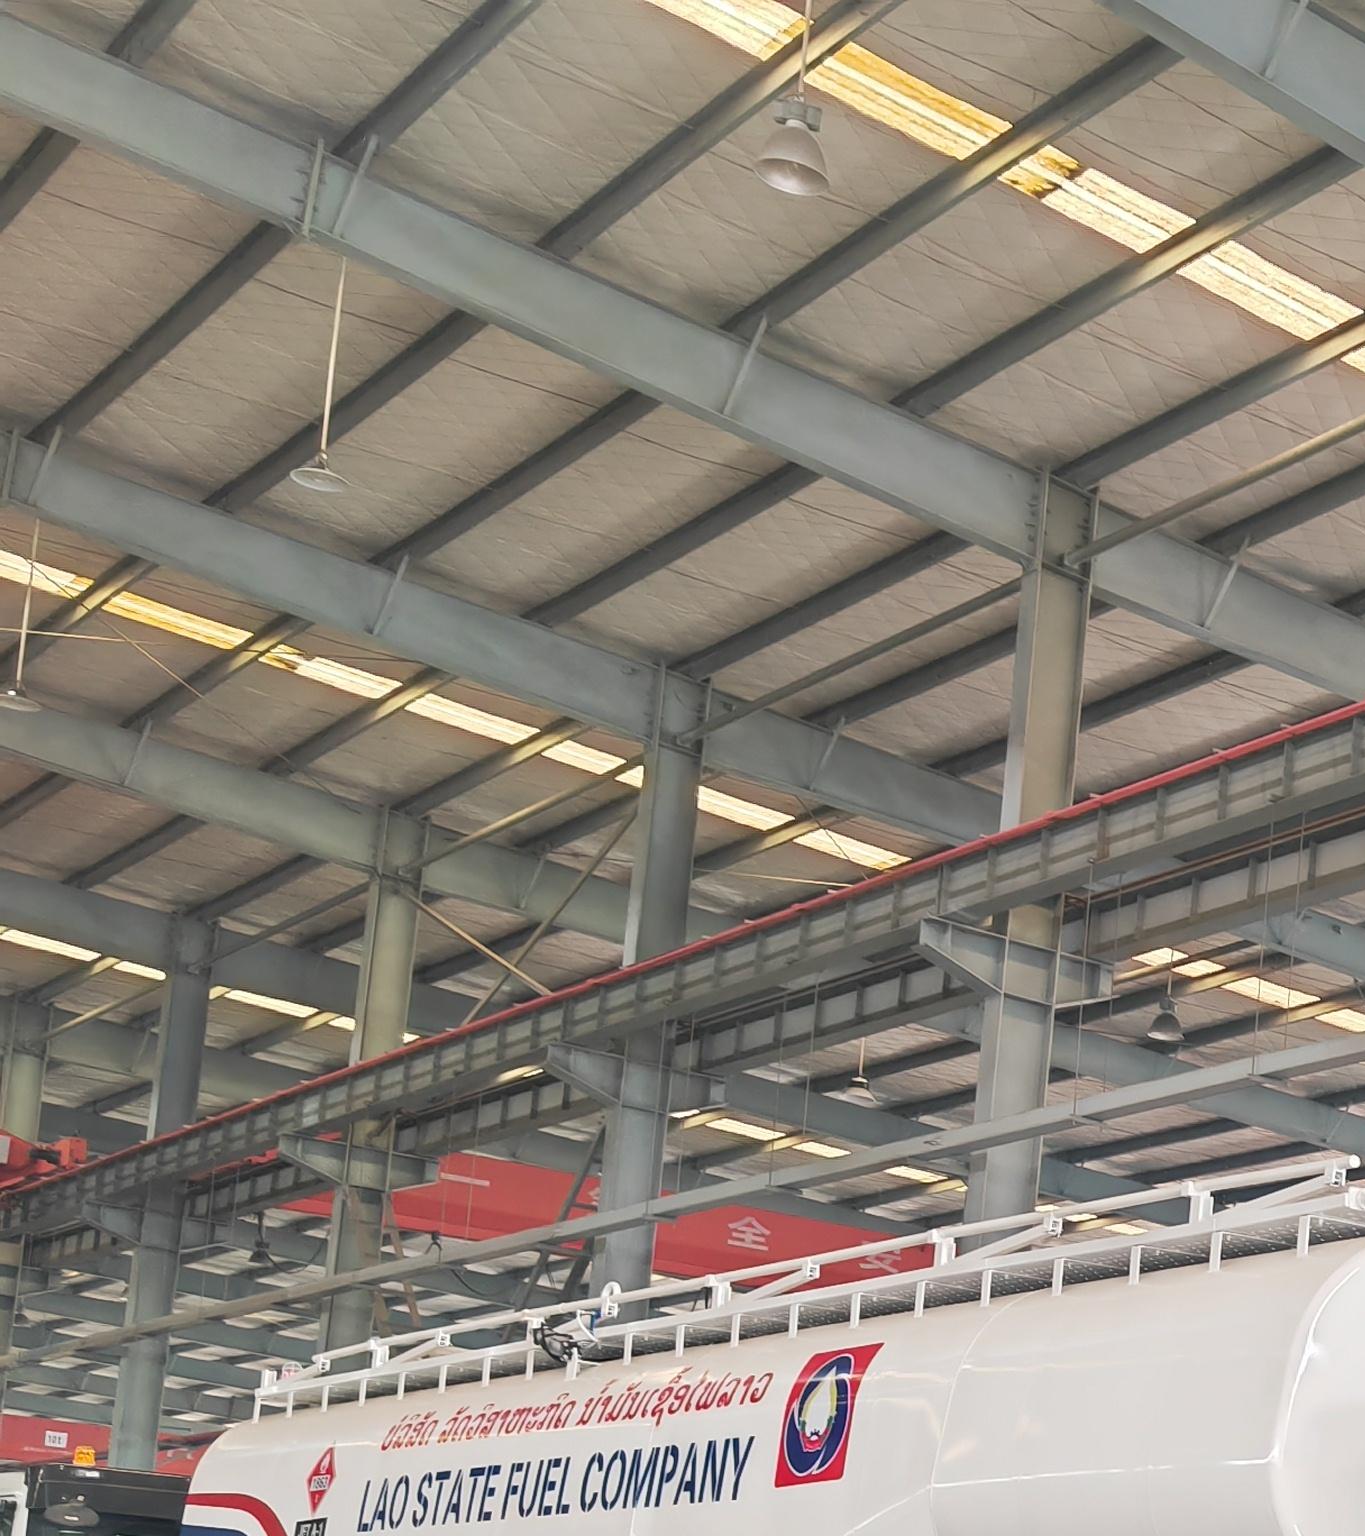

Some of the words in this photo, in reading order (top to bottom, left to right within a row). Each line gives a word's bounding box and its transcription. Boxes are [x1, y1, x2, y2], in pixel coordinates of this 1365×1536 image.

[356, 1473, 410, 1533] LAO
[412, 1464, 501, 1528] STATE
[500, 1456, 571, 1521] FUEL
[580, 1435, 756, 1513] COMPANY
